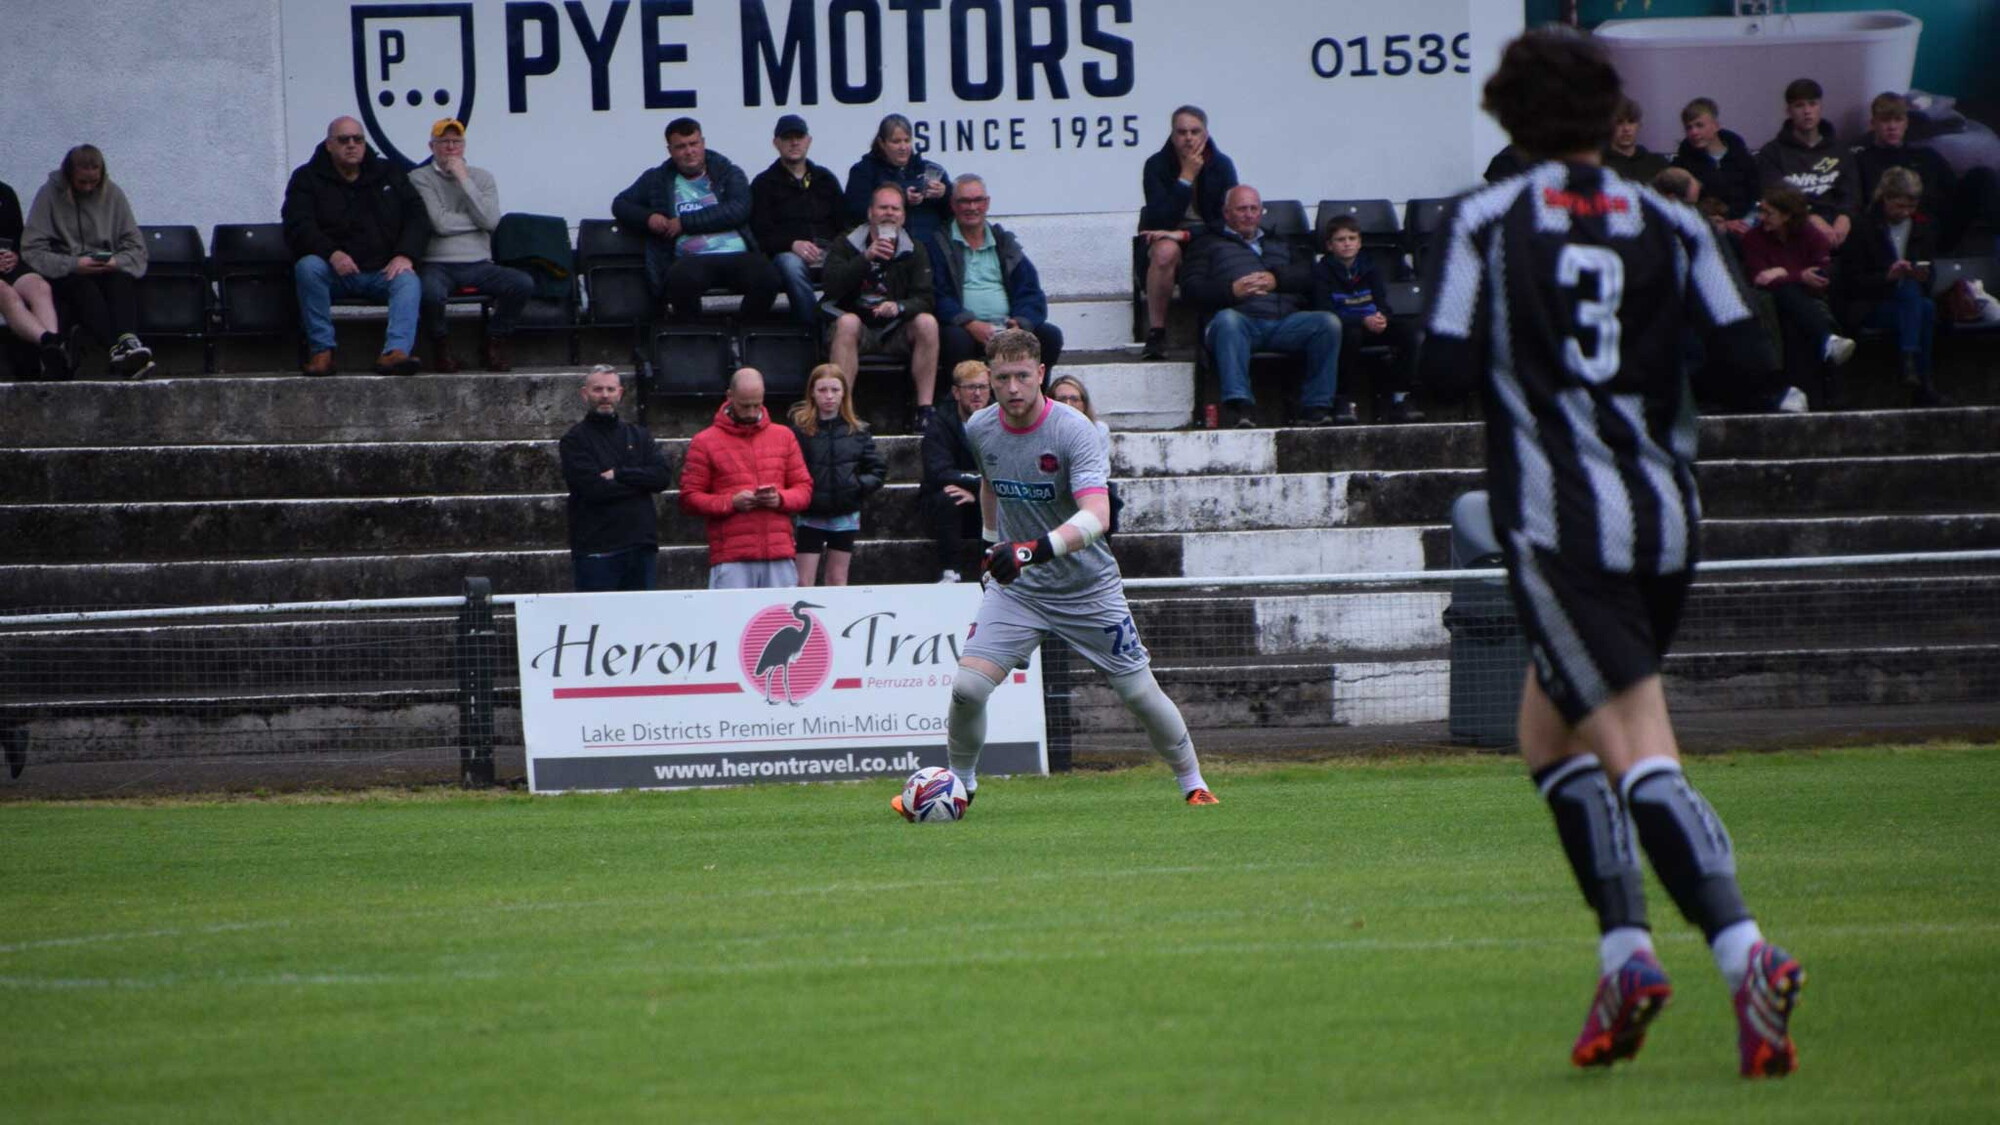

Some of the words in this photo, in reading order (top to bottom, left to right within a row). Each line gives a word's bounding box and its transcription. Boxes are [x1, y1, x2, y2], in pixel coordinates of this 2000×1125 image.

[378, 29, 406, 82] P
[505, 0, 698, 113] PYE
[741, 0, 1135, 107] MOTORS
[914, 117, 1027, 153] SINCE
[1051, 114, 1140, 149] 1925
[1557, 243, 1625, 384] 3
[531, 623, 718, 678] Heron
[841, 611, 963, 668] Trav
[927, 674, 938, 687] &
[581, 725, 626, 743] Lake
[633, 721, 712, 741] Districts
[719, 718, 796, 738] Premier
[802, 713, 899, 736] Mini-Midi
[905, 712, 950, 732] Coac
[653, 751, 921, 781] www.herontravel.co.uk
